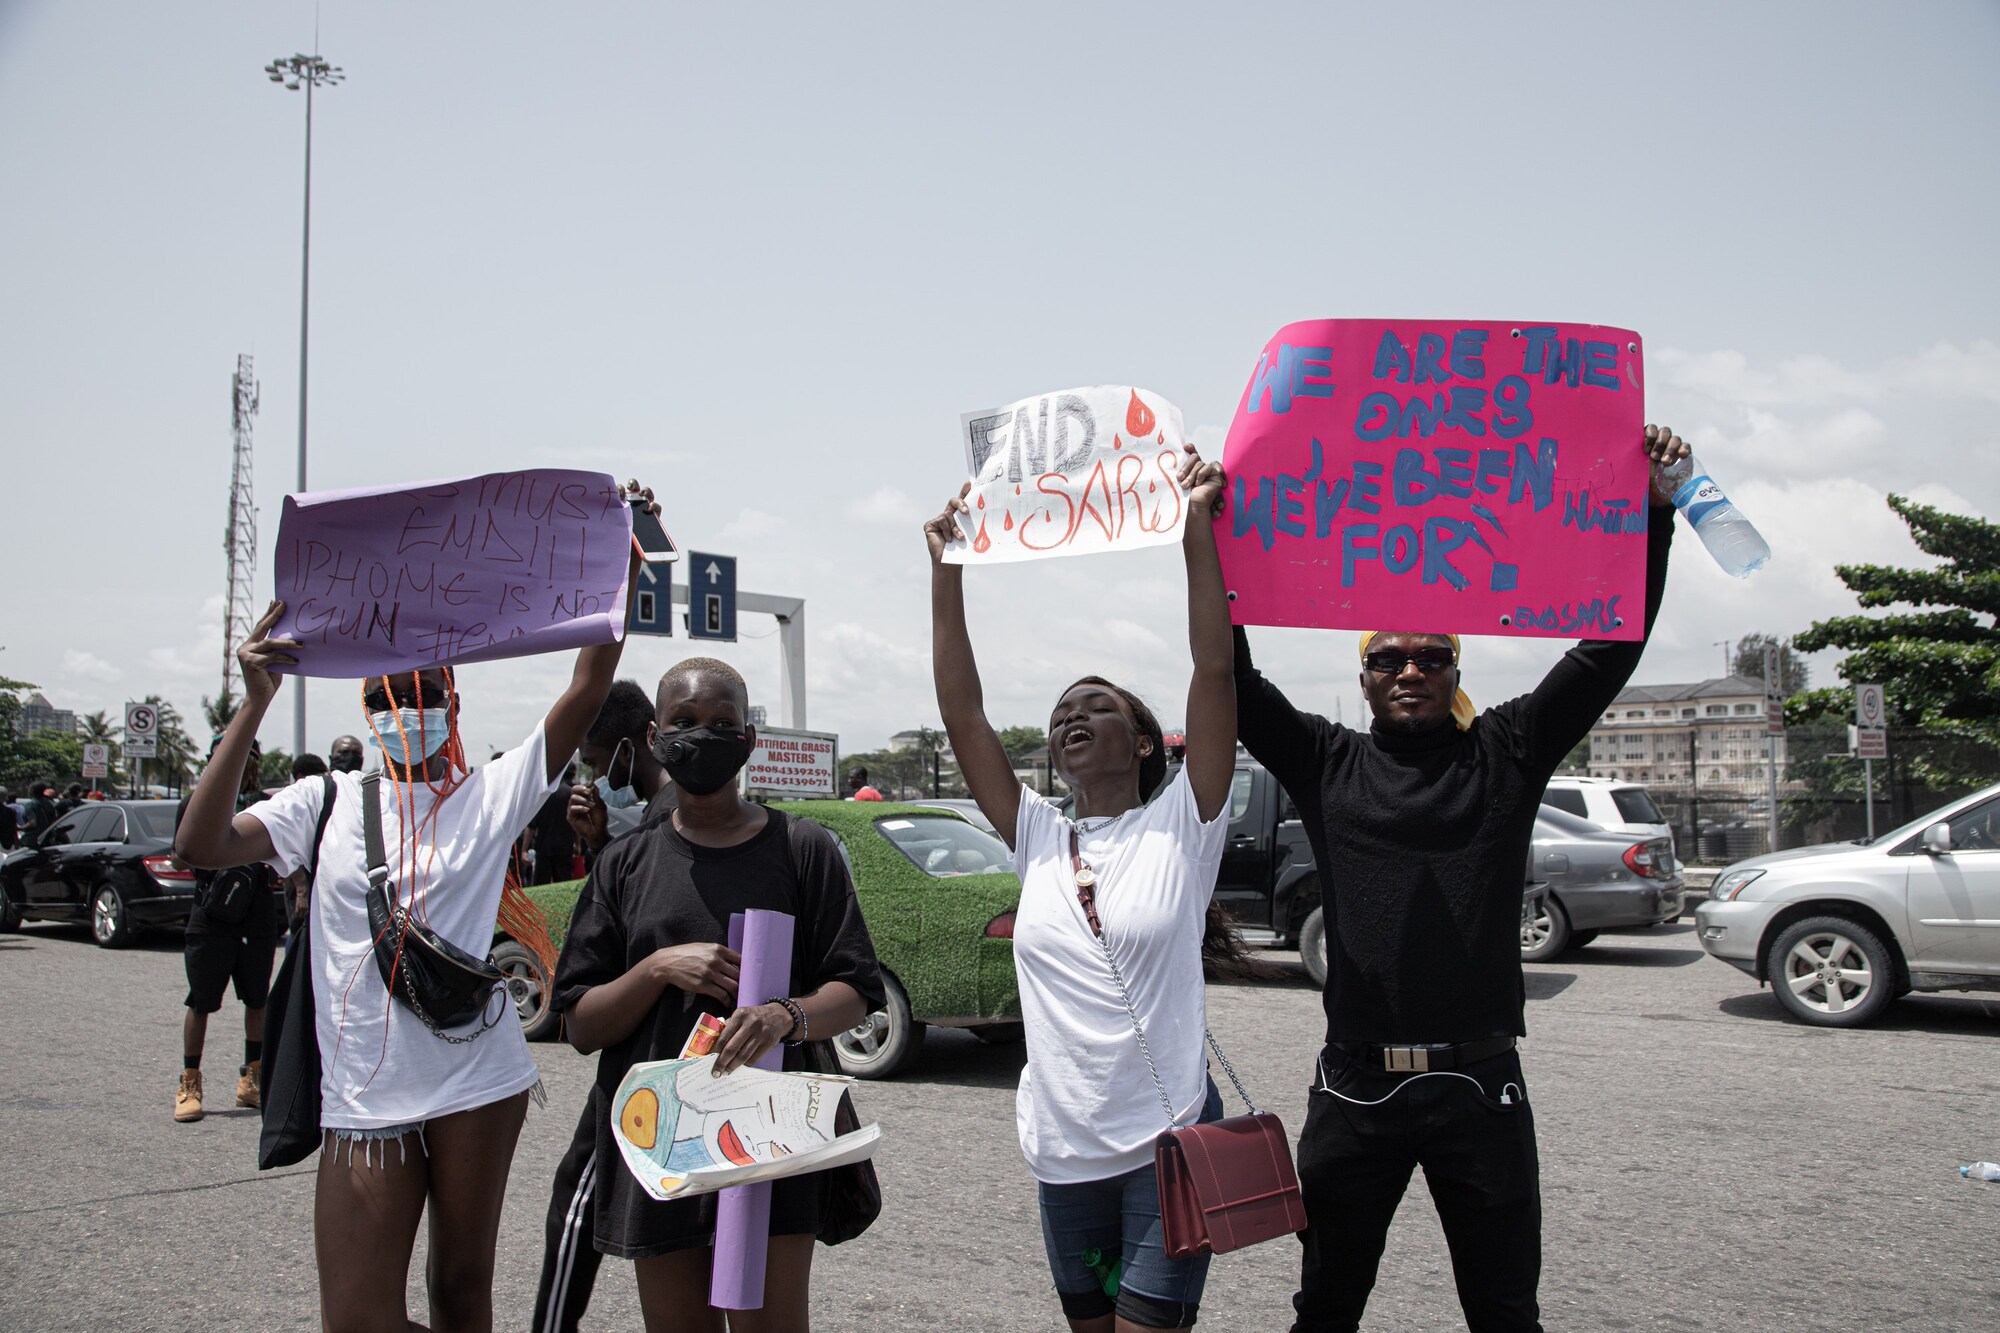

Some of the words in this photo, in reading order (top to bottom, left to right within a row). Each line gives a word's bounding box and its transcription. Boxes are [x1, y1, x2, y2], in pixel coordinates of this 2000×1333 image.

[1248, 344, 1337, 414] WE
[1372, 329, 1489, 385] ARE
[1521, 327, 1620, 391] THE
[969, 394, 1096, 486] END
[1354, 375, 1534, 442] ONES
[478, 473, 618, 527] MUST
[1018, 450, 1181, 550] SARS
[1392, 438, 1557, 512] BEEN
[293, 539, 480, 608] IPHONE
[499, 583, 531, 615] IS
[295, 598, 399, 648] GUN
[755, 738, 799, 751] RTIFICIAL
[801, 742, 831, 753] GRASS
[767, 750, 816, 764] MASTERS
[751, 775, 828, 787] 08145139671
